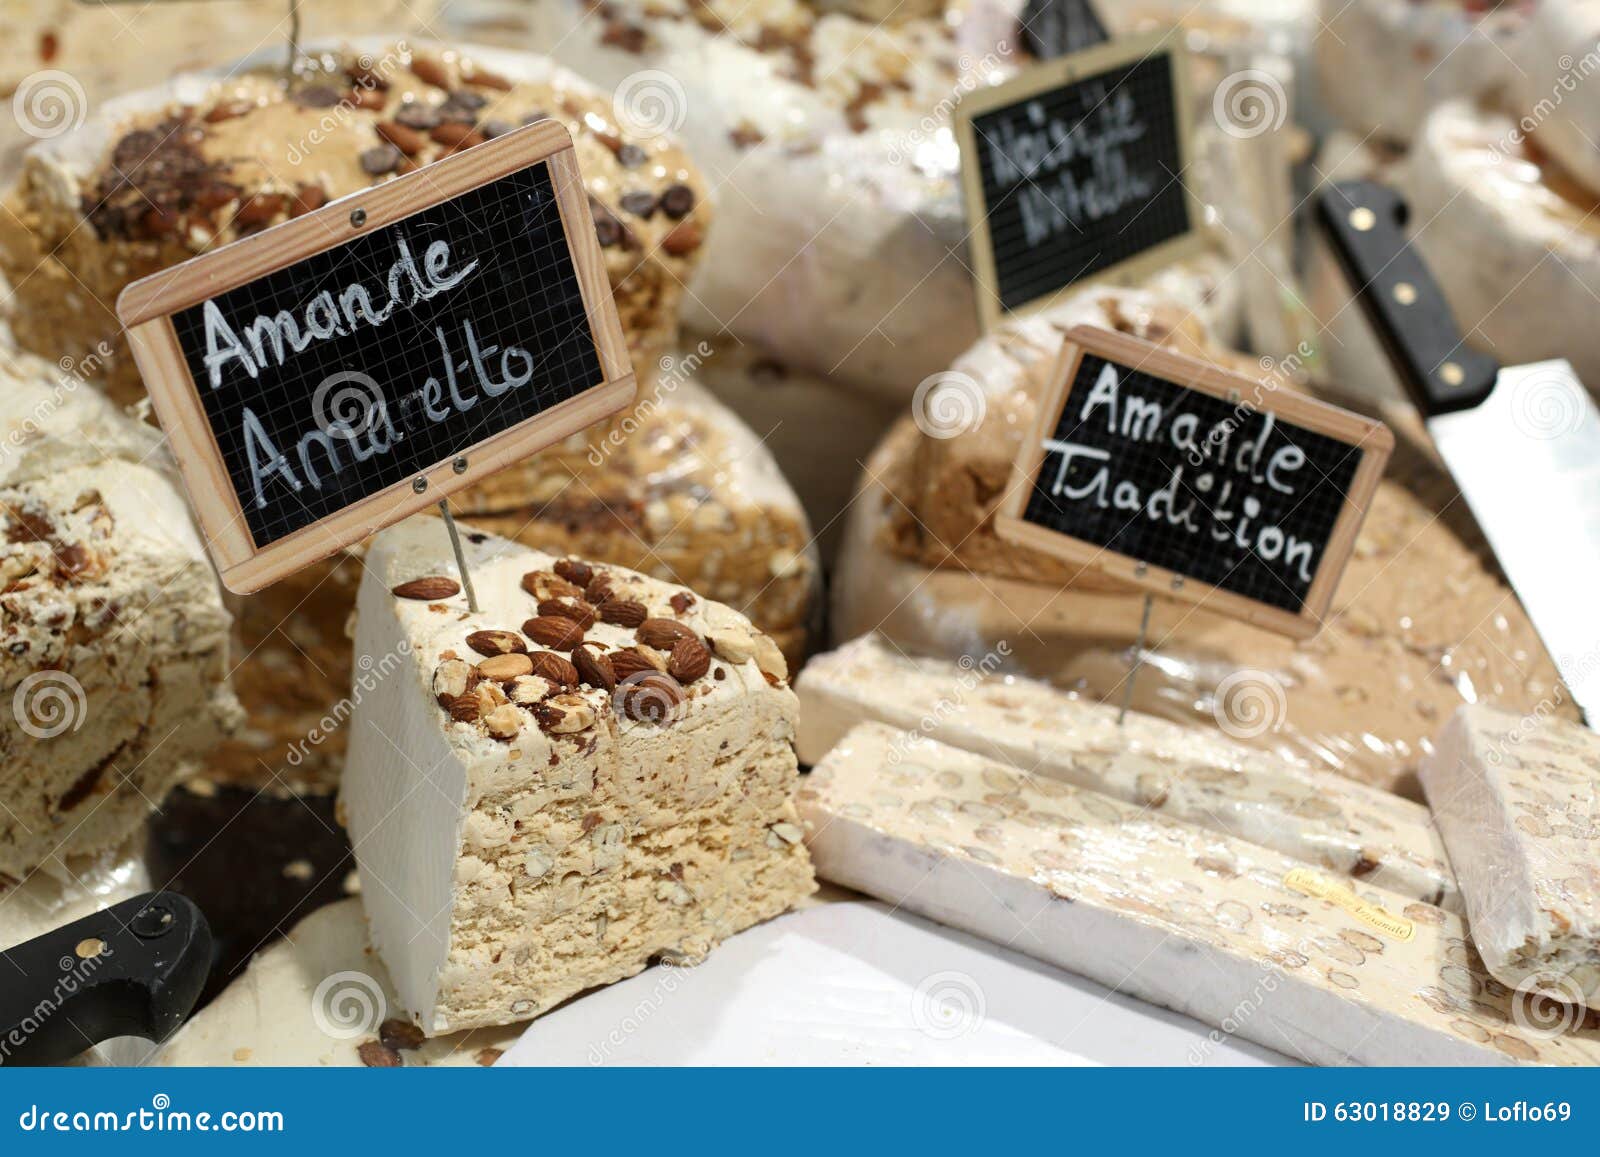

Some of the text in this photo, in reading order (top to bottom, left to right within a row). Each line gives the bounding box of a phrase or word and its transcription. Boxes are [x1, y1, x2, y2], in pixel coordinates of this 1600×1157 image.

[203, 230, 479, 389] Amande
[243, 317, 534, 509] Amaretto
[1080, 362, 1306, 495] Amande
[1041, 438, 1312, 582] Tradition
